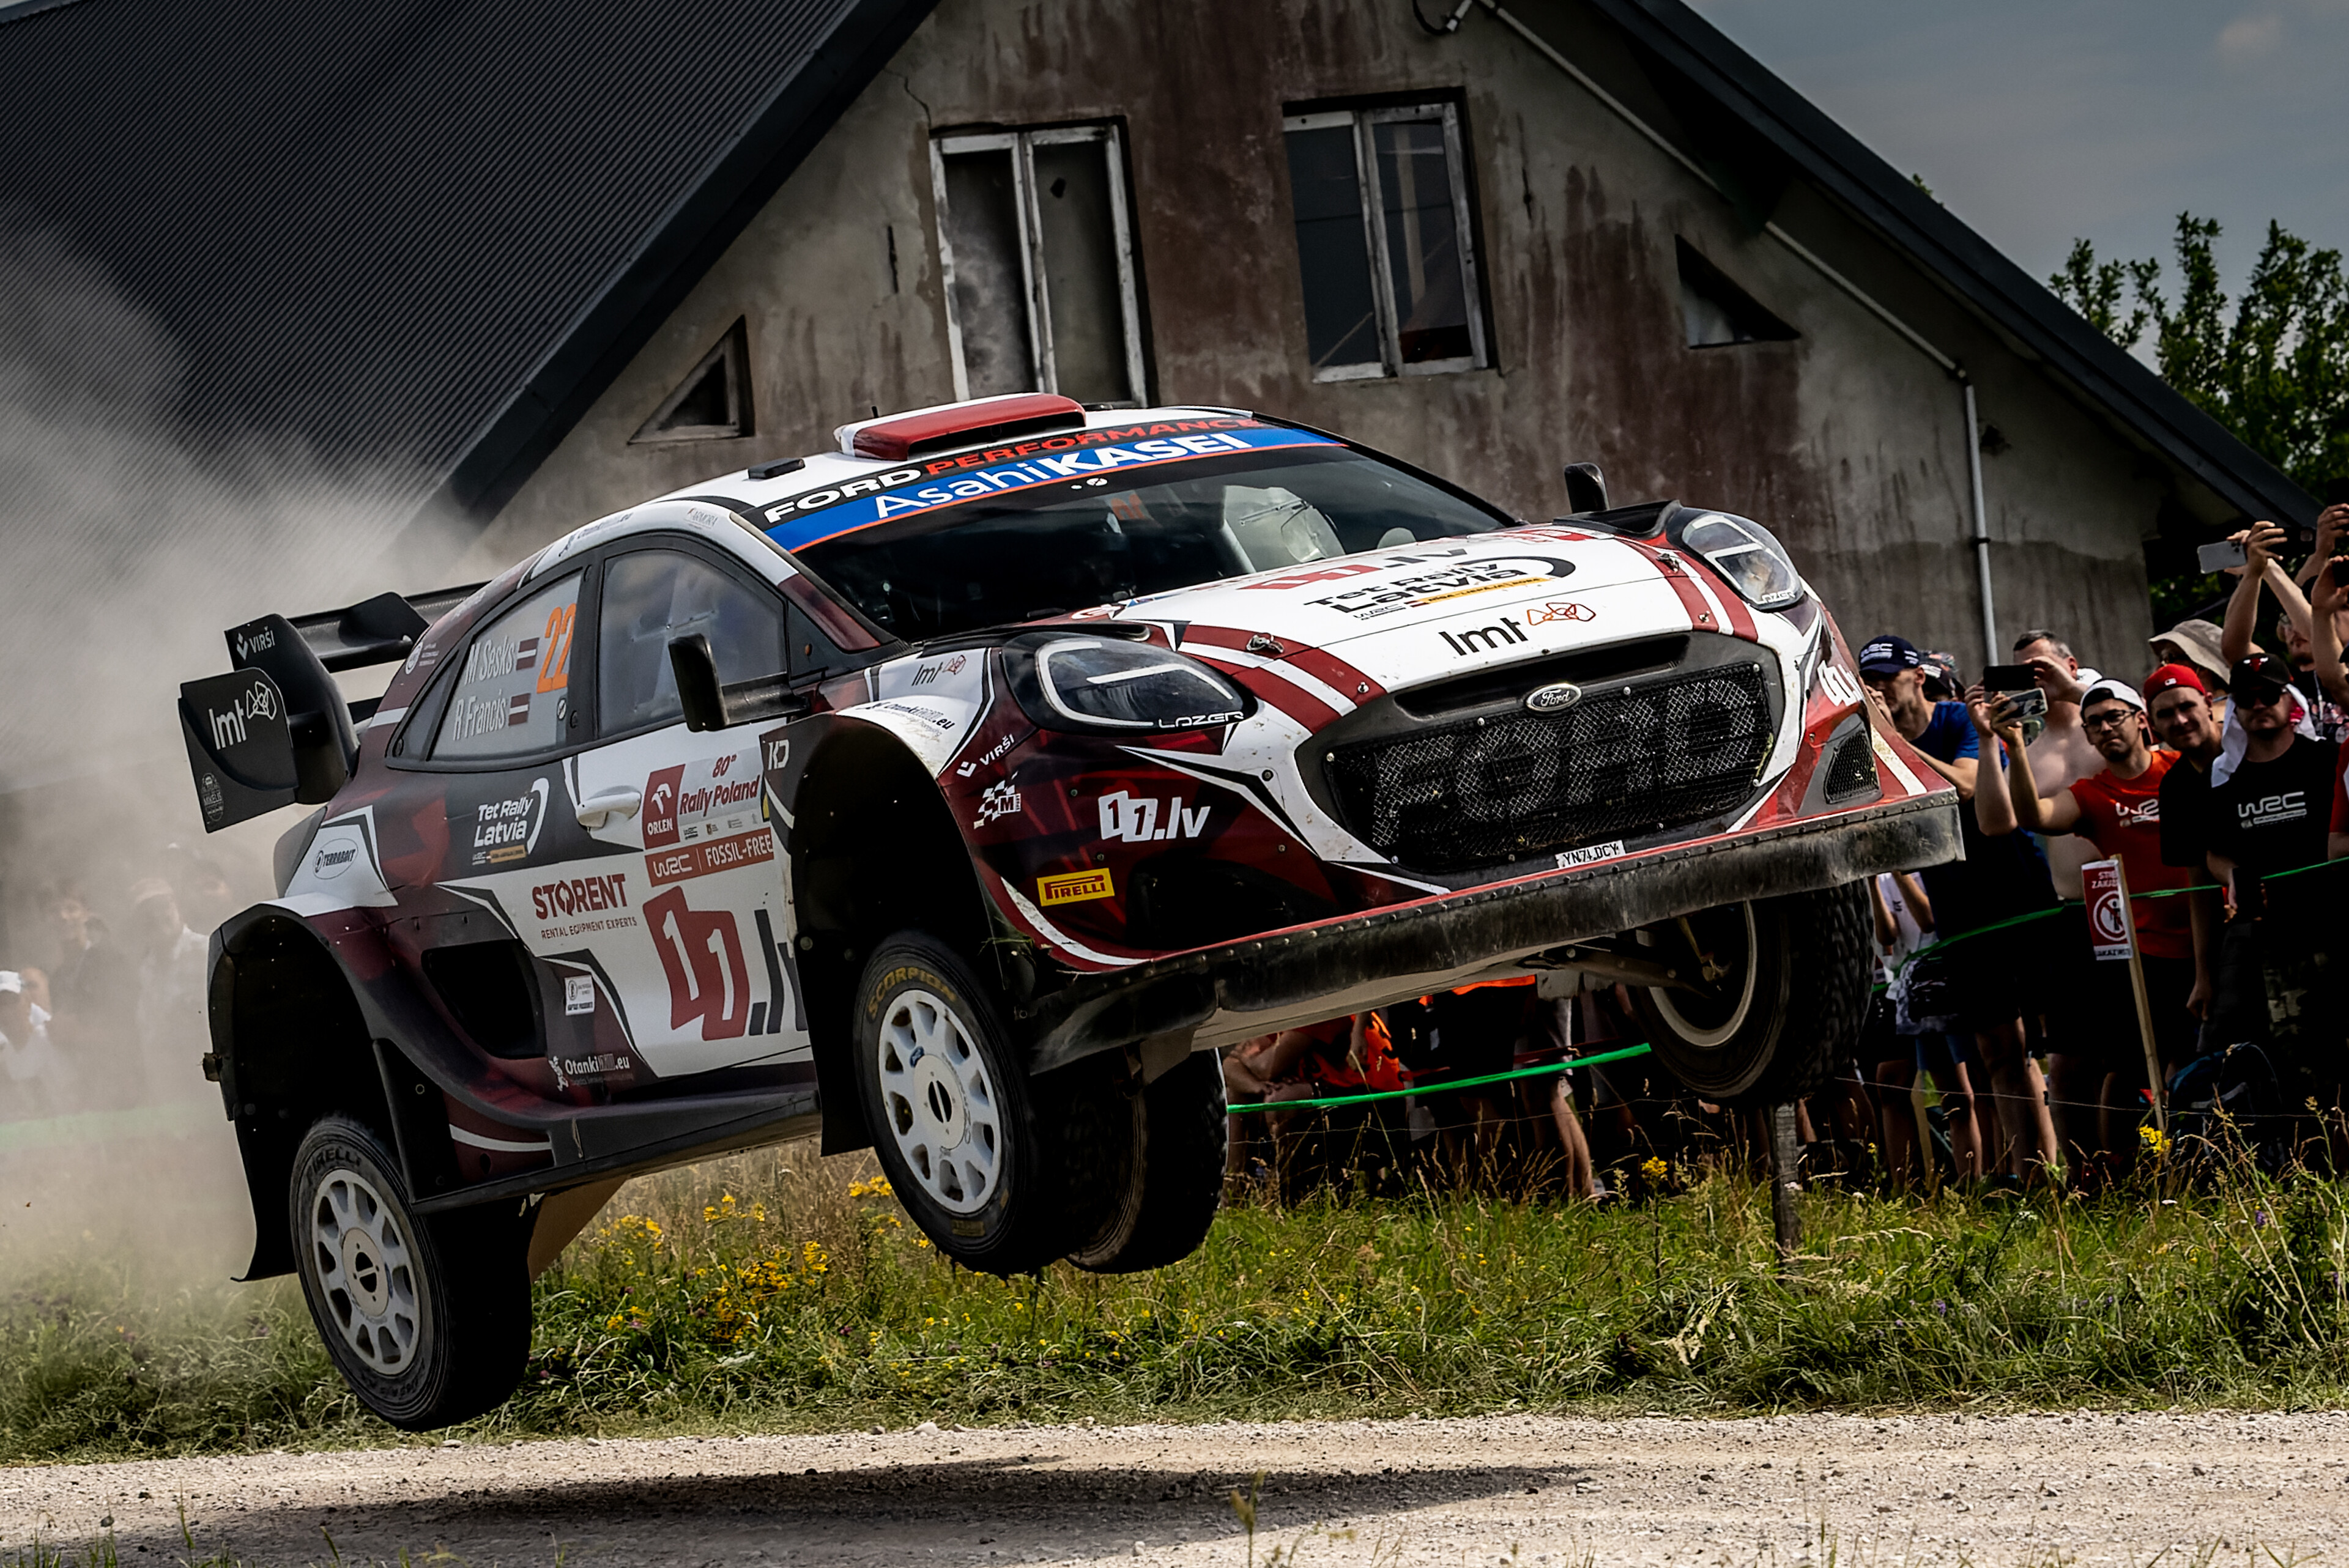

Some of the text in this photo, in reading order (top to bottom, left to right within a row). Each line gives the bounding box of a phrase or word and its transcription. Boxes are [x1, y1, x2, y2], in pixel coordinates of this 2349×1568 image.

[764, 418, 1265, 523] FORD PERFORMANCE
[1304, 563, 1497, 605] Tet Rally
[1329, 569, 1528, 613] Latvia
[249, 626, 275, 653] VIRŠI
[536, 602, 577, 693] 22
[1438, 618, 1528, 656] lmt
[464, 642, 481, 686] M
[479, 635, 515, 681] Sesks
[911, 662, 944, 686] lmt
[453, 689, 507, 741] R Francis
[1541, 689, 1571, 708] Ford
[209, 699, 247, 750] lmt
[1159, 711, 1244, 728] LAZER
[979, 734, 1015, 766] VIRŠI
[1372, 678, 1757, 848] FORD
[478, 796, 534, 822] Tet Rally
[680, 774, 760, 817] Rally Poland
[2115, 798, 2159, 816] WR
[2238, 791, 2306, 818] WRC
[474, 816, 527, 848] Latvia
[647, 818, 674, 835] ORLEN
[1098, 790, 1211, 843] 11.lv
[653, 834, 773, 878] WRC FOSSIL-FREE
[532, 873, 628, 920] STORENT
[1044, 875, 1107, 900] PIRELLI
[541, 916, 637, 940] RENTAL EQUIPMENT EXPERTS
